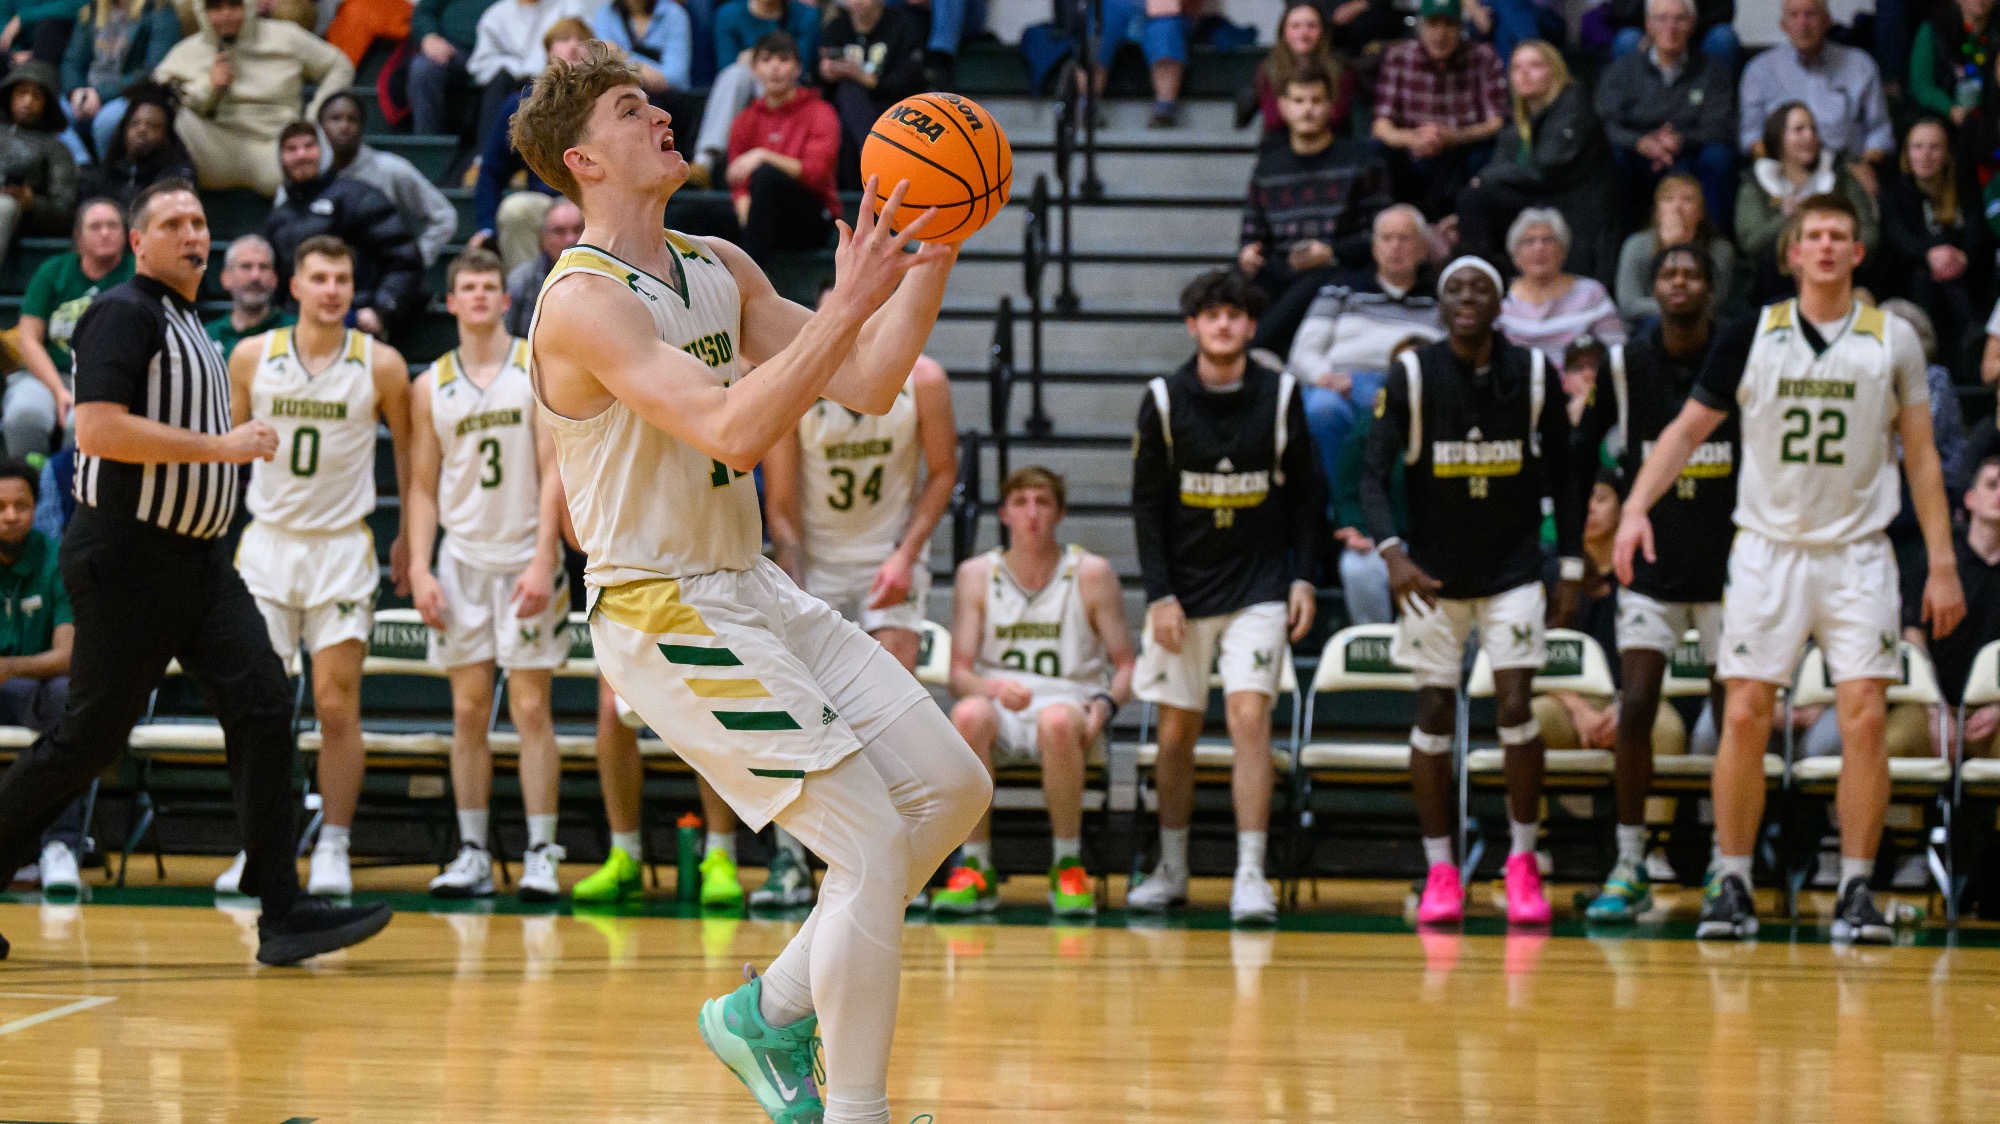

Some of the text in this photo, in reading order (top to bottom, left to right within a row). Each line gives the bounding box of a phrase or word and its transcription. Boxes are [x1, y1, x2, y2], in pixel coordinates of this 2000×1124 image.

[885, 105, 946, 143] NCAA
[680, 330, 734, 368] SSO
[271, 397, 347, 419] HUSSON
[1778, 378, 1856, 400] HUSSON
[290, 426, 321, 478] 0
[1432, 440, 1523, 465] HUSSON
[1781, 406, 1847, 466] 22
[477, 436, 503, 490] 3
[826, 464, 884, 510] 34
[1181, 469, 1269, 496] HUSSON
[373, 624, 428, 647] HUSSO
